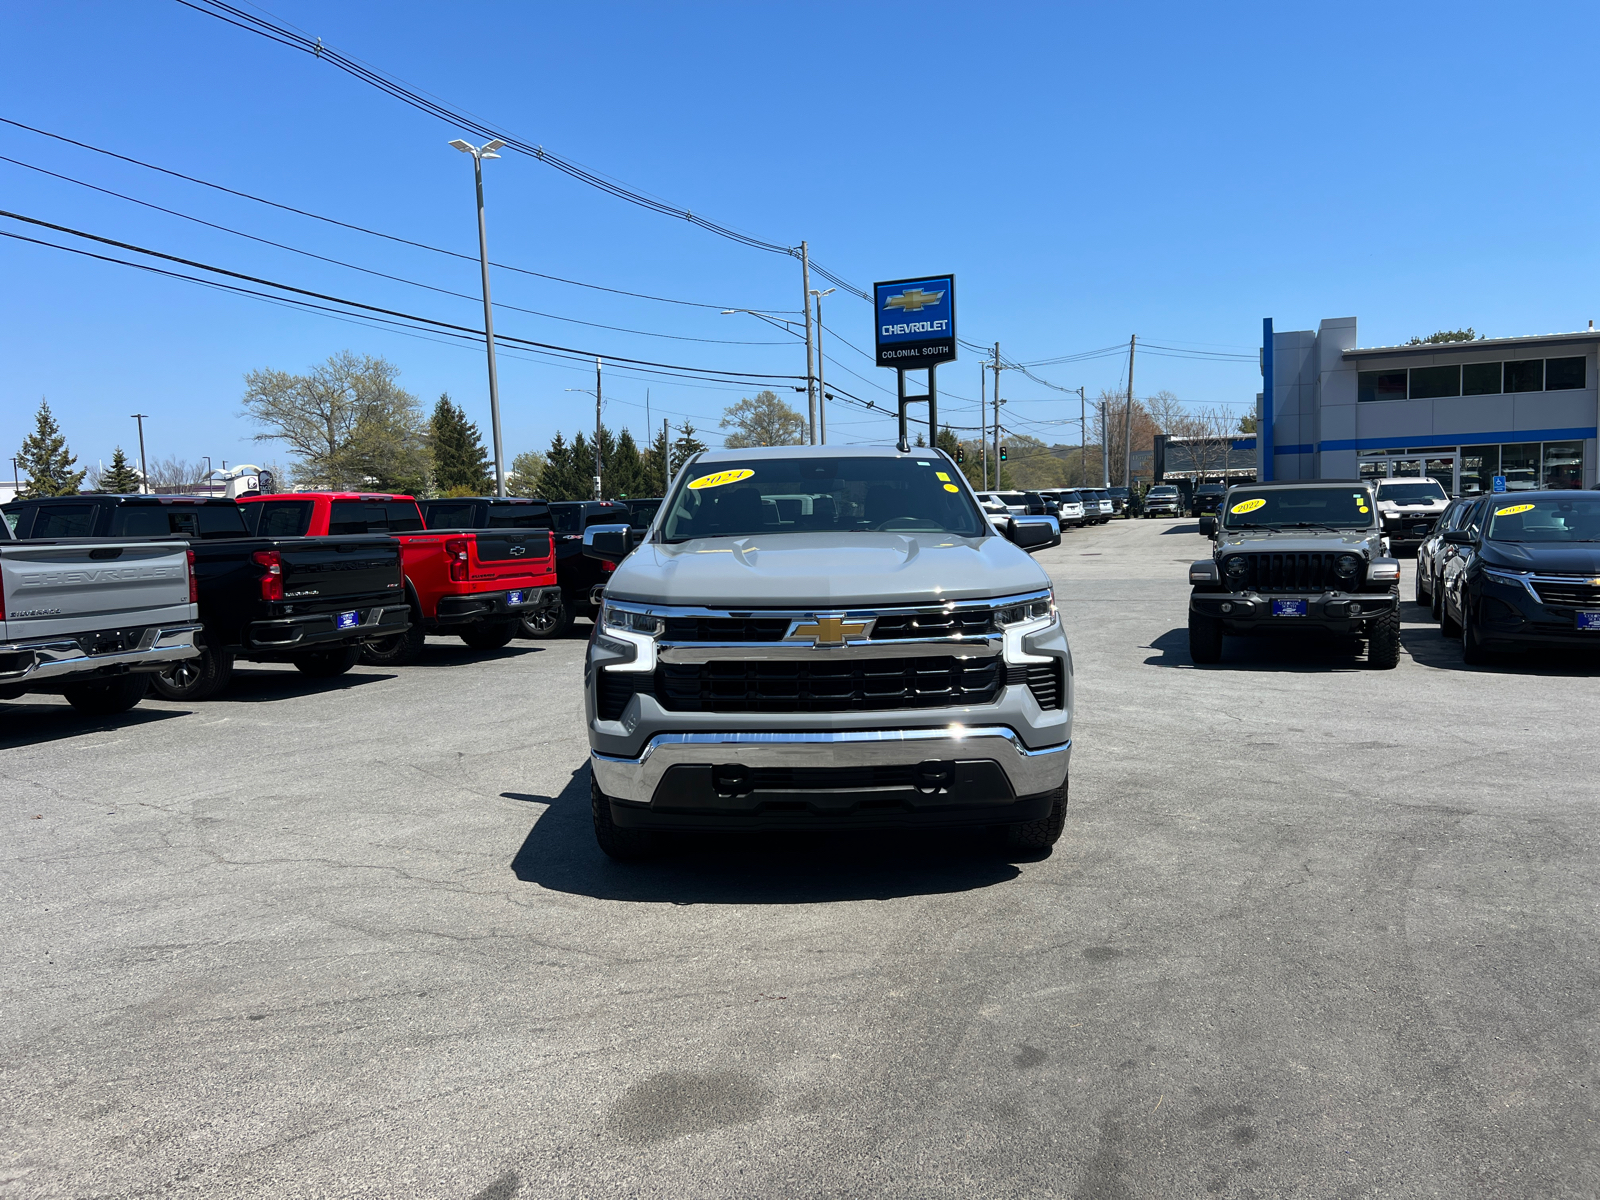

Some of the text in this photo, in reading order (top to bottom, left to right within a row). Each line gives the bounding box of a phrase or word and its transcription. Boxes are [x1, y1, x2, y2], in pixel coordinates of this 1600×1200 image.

[882, 320, 948, 336] CHEVROLET
[882, 346, 949, 359] COLONIAL SOUTH
[699, 470, 745, 487] 2024
[1237, 500, 1260, 513] 2022
[22, 565, 181, 587] CHEVROLET
[9, 608, 62, 618] SILVERADO
